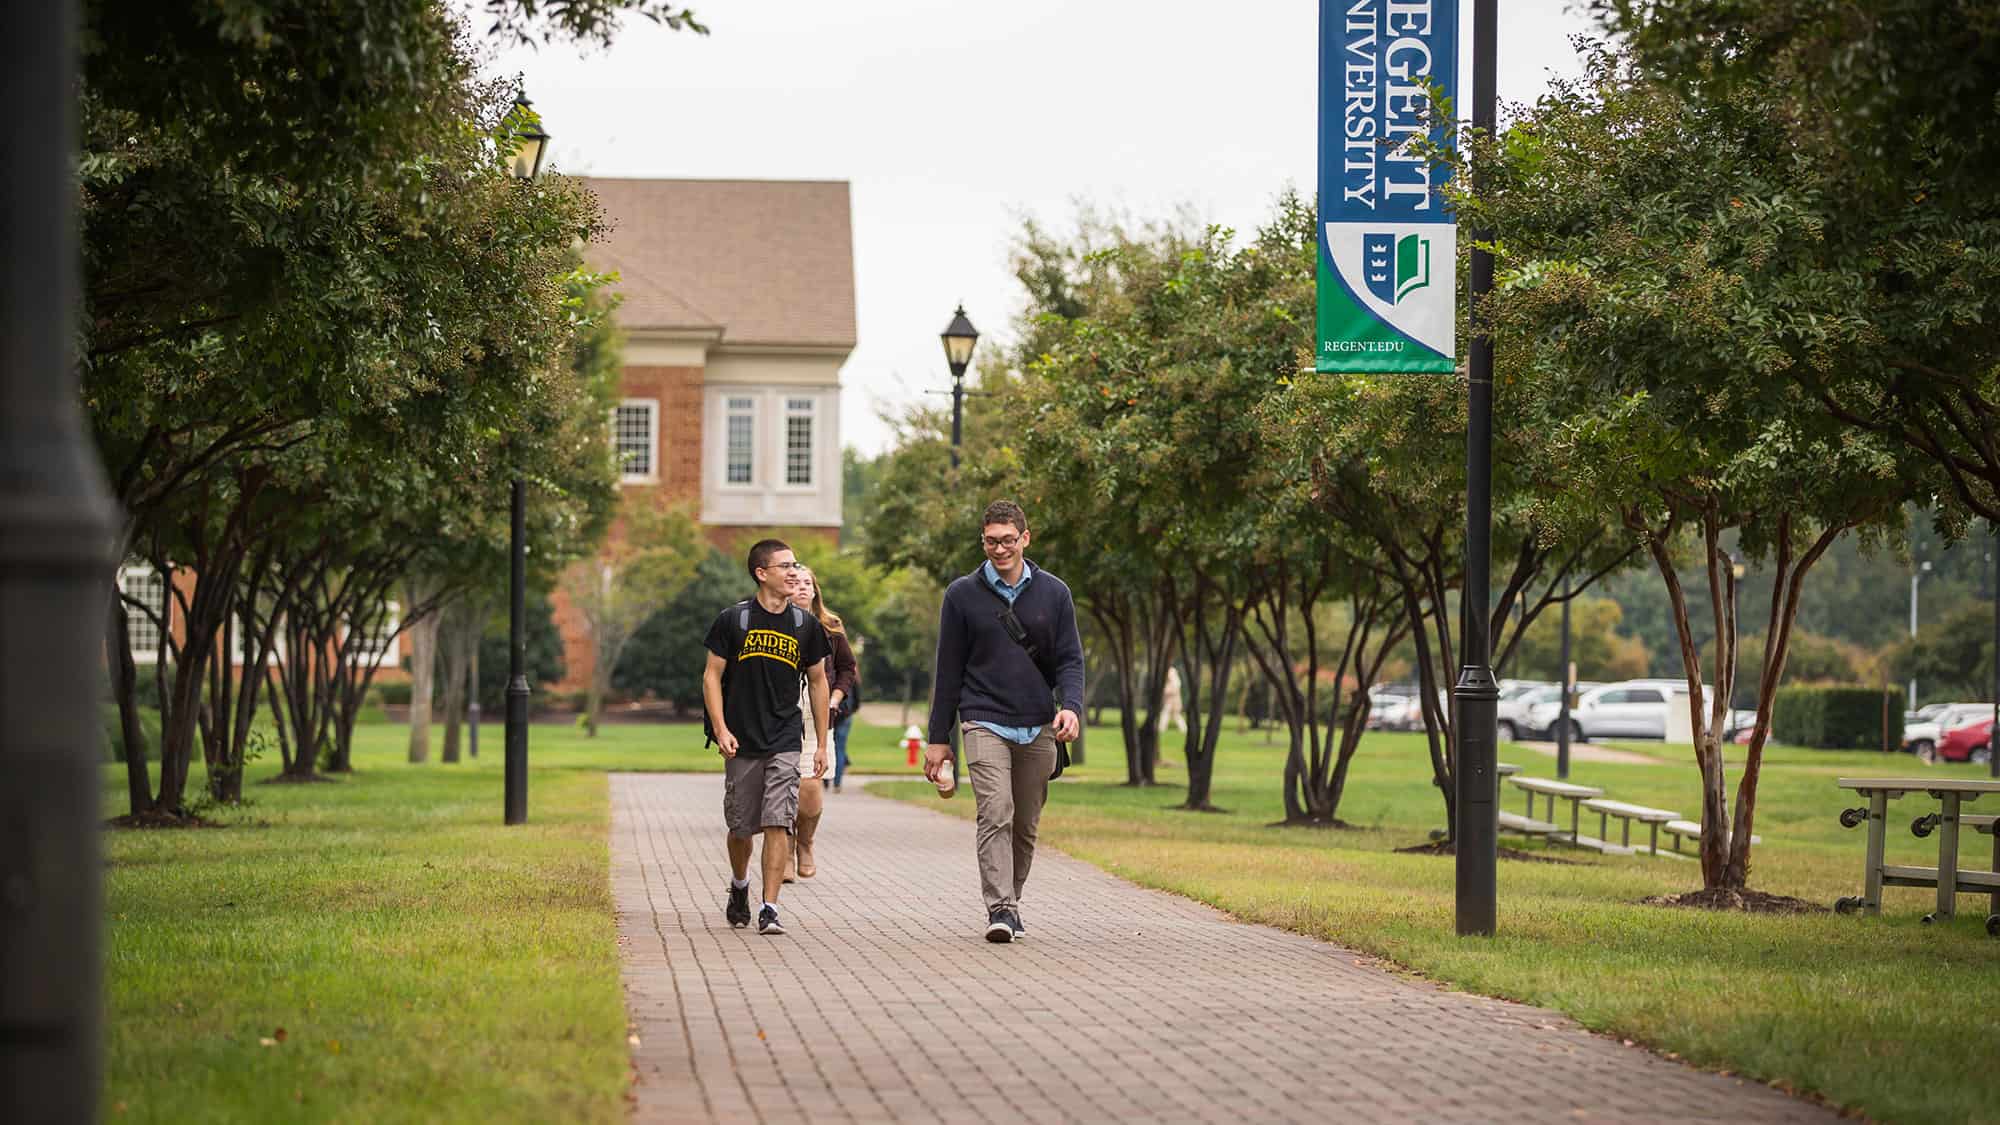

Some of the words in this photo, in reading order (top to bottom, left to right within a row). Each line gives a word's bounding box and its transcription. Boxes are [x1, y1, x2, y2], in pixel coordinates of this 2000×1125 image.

[1344, 0, 1377, 210] NIVERSITY
[1385, 0, 1431, 210] EGENT
[1324, 341, 1404, 352] REGENT.EDU
[744, 634, 797, 656] RAIDER
